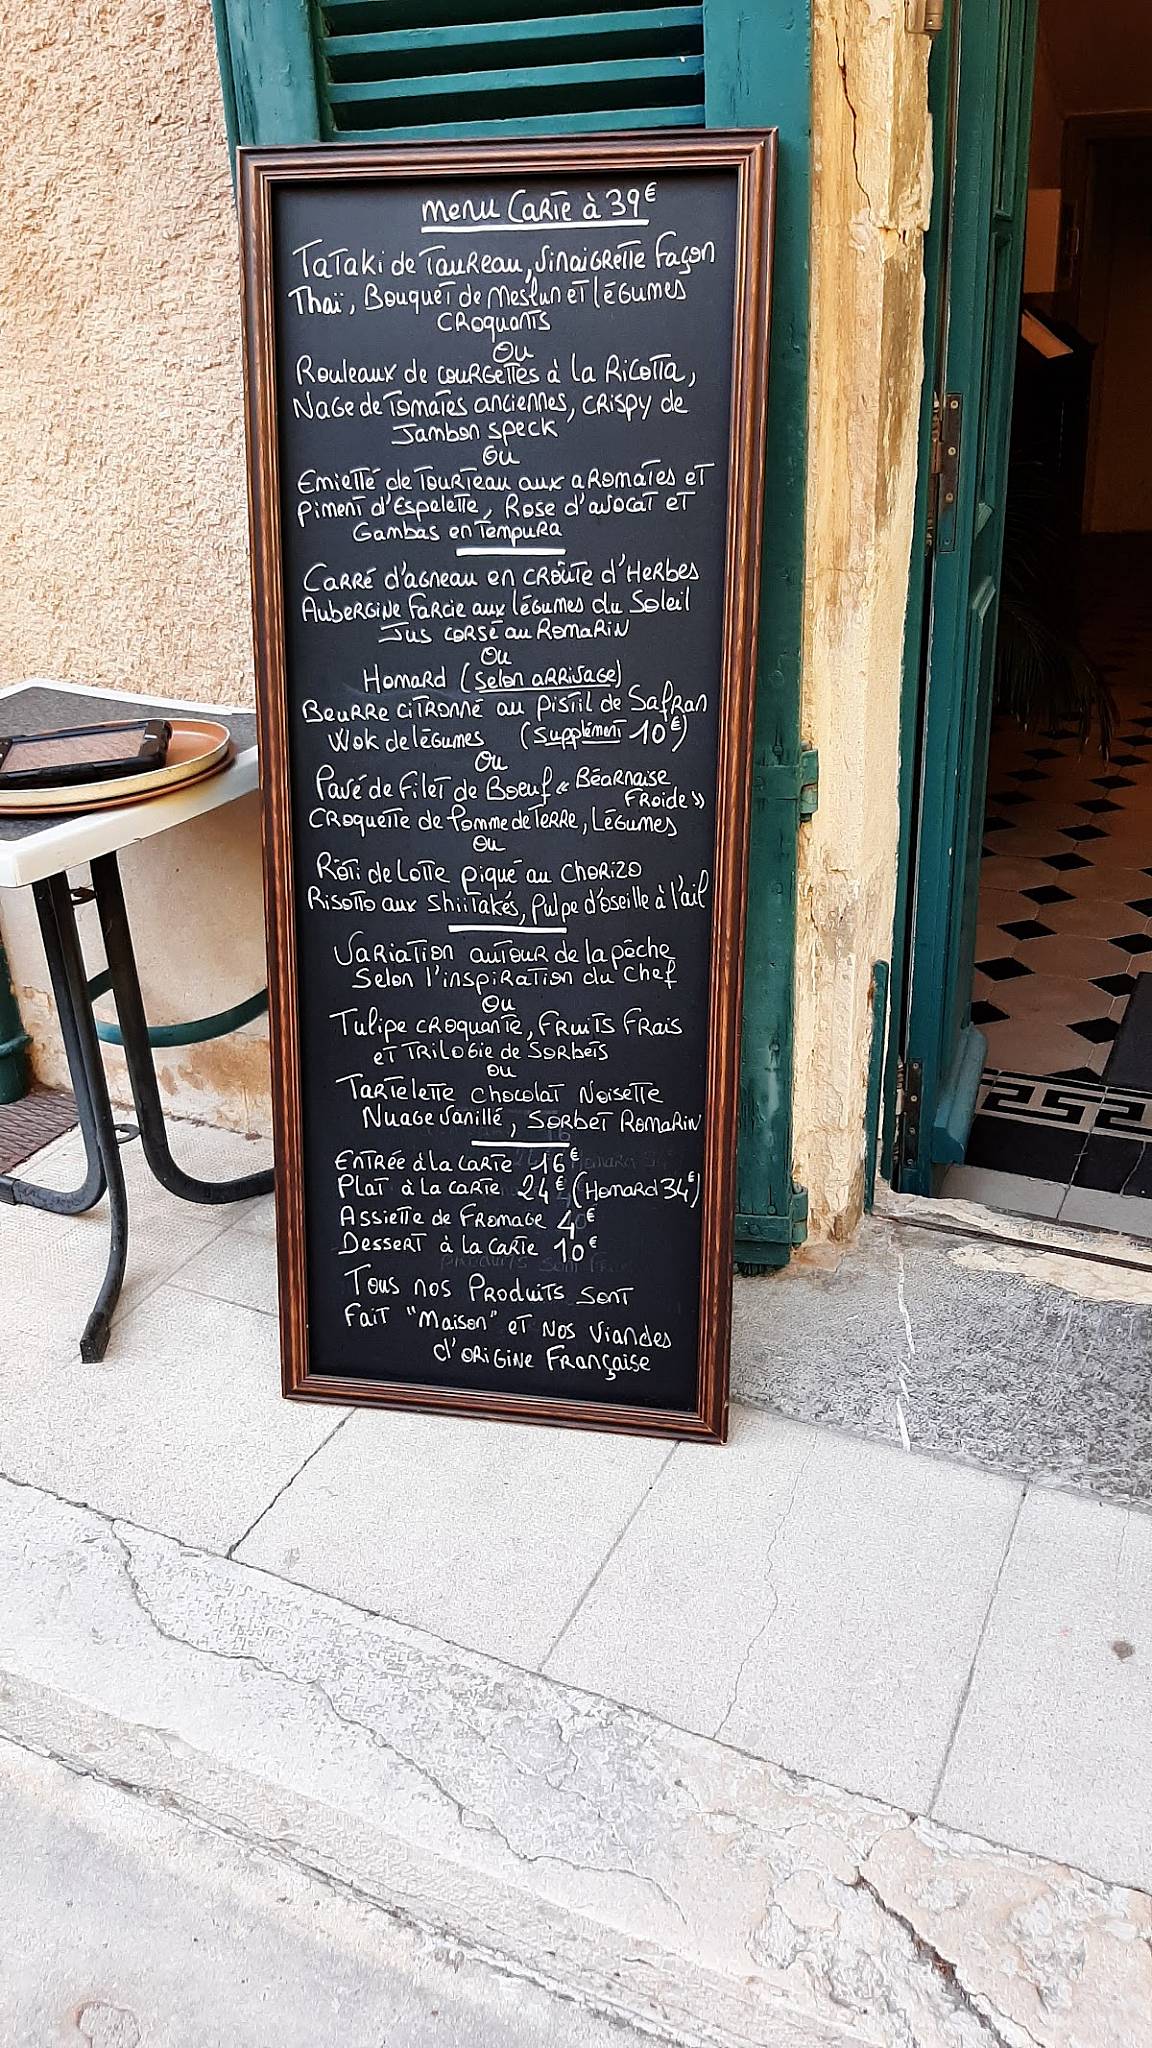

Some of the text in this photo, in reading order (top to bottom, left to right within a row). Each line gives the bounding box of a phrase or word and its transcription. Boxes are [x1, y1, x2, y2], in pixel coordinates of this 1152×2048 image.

[582, 191, 602, 220] à
[292, 238, 385, 279] Tataki
[390, 250, 417, 277] de
[364, 280, 457, 315] Bouquet
[458, 282, 482, 308] de
[567, 279, 590, 304] et
[593, 275, 687, 309] légumes
[296, 354, 398, 386] Rouleaux
[404, 358, 428, 384] de
[546, 358, 561, 384] à
[571, 352, 597, 384] la
[292, 390, 354, 420] Nage
[359, 391, 383, 417] de
[660, 388, 689, 414] de
[391, 421, 480, 445] Jambon
[385, 468, 413, 491] de
[413, 465, 512, 491] Tourteau
[518, 475, 565, 492] aux
[685, 462, 715, 486] et
[505, 492, 556, 519] Rose
[564, 490, 659, 516] d'avocat
[665, 491, 696, 511] et
[352, 520, 440, 542] Gambas
[448, 524, 473, 539] en
[303, 562, 377, 592] Carré
[384, 560, 478, 590] d'agneau
[487, 568, 515, 587] en
[301, 596, 402, 624] Aubergine
[471, 602, 506, 618] aux
[511, 588, 585, 617] légumes
[591, 591, 624, 615] du
[629, 586, 690, 614] Soleil
[378, 621, 433, 644] Jus
[504, 626, 533, 640] au
[363, 663, 446, 694] Homard
[496, 701, 525, 717] au
[600, 693, 622, 713] de
[628, 680, 708, 723] Safran
[327, 724, 485, 753] Wok de légumes
[316, 764, 672, 803] Pavé de Filet de Béarnaise
[624, 786, 688, 810] Froide
[308, 807, 411, 838] Croquette
[418, 809, 444, 831] de
[511, 809, 532, 830] de
[591, 806, 678, 837] Légumes
[316, 851, 361, 881] Rôti
[367, 861, 393, 885] de
[525, 868, 553, 884] au
[560, 860, 642, 883] Chorizo
[307, 869, 709, 925] Risotto aux Pulpe d'oseille à l'ail
[469, 939, 549, 964] autour
[554, 939, 580, 964] de
[585, 938, 609, 965] la
[611, 935, 676, 971] pêche
[351, 967, 414, 989] Selon
[426, 964, 573, 996] l'inspiration
[582, 966, 615, 985] du
[328, 1006, 683, 1044] Tulipe Fruits Frais
[373, 1045, 398, 1066] et
[500, 1042, 522, 1060] de
[527, 1040, 609, 1061] Sorbets
[335, 1073, 664, 1105] Tartelette Chocolat Noisette
[362, 1103, 435, 1129] Nuage
[527, 1108, 614, 1132] Sorbet
[334, 1149, 406, 1171] Entrée
[412, 1152, 427, 1172] à
[428, 1149, 454, 1172] la
[337, 1173, 390, 1199] Plat
[401, 1178, 415, 1196] à
[420, 1177, 442, 1195] la
[340, 1205, 425, 1227] Assiette
[431, 1208, 452, 1226] de
[459, 1202, 547, 1229] Fromage
[338, 1231, 427, 1255] Dessert
[439, 1234, 454, 1254] à
[462, 1234, 484, 1255] la
[343, 1263, 400, 1296] Tous
[414, 1278, 452, 1298] nos
[468, 1272, 565, 1303] Produits
[344, 1302, 390, 1328] Fait
[508, 1313, 533, 1335] et
[542, 1320, 576, 1340] Nos
[433, 1337, 651, 1381] d'origine Française
